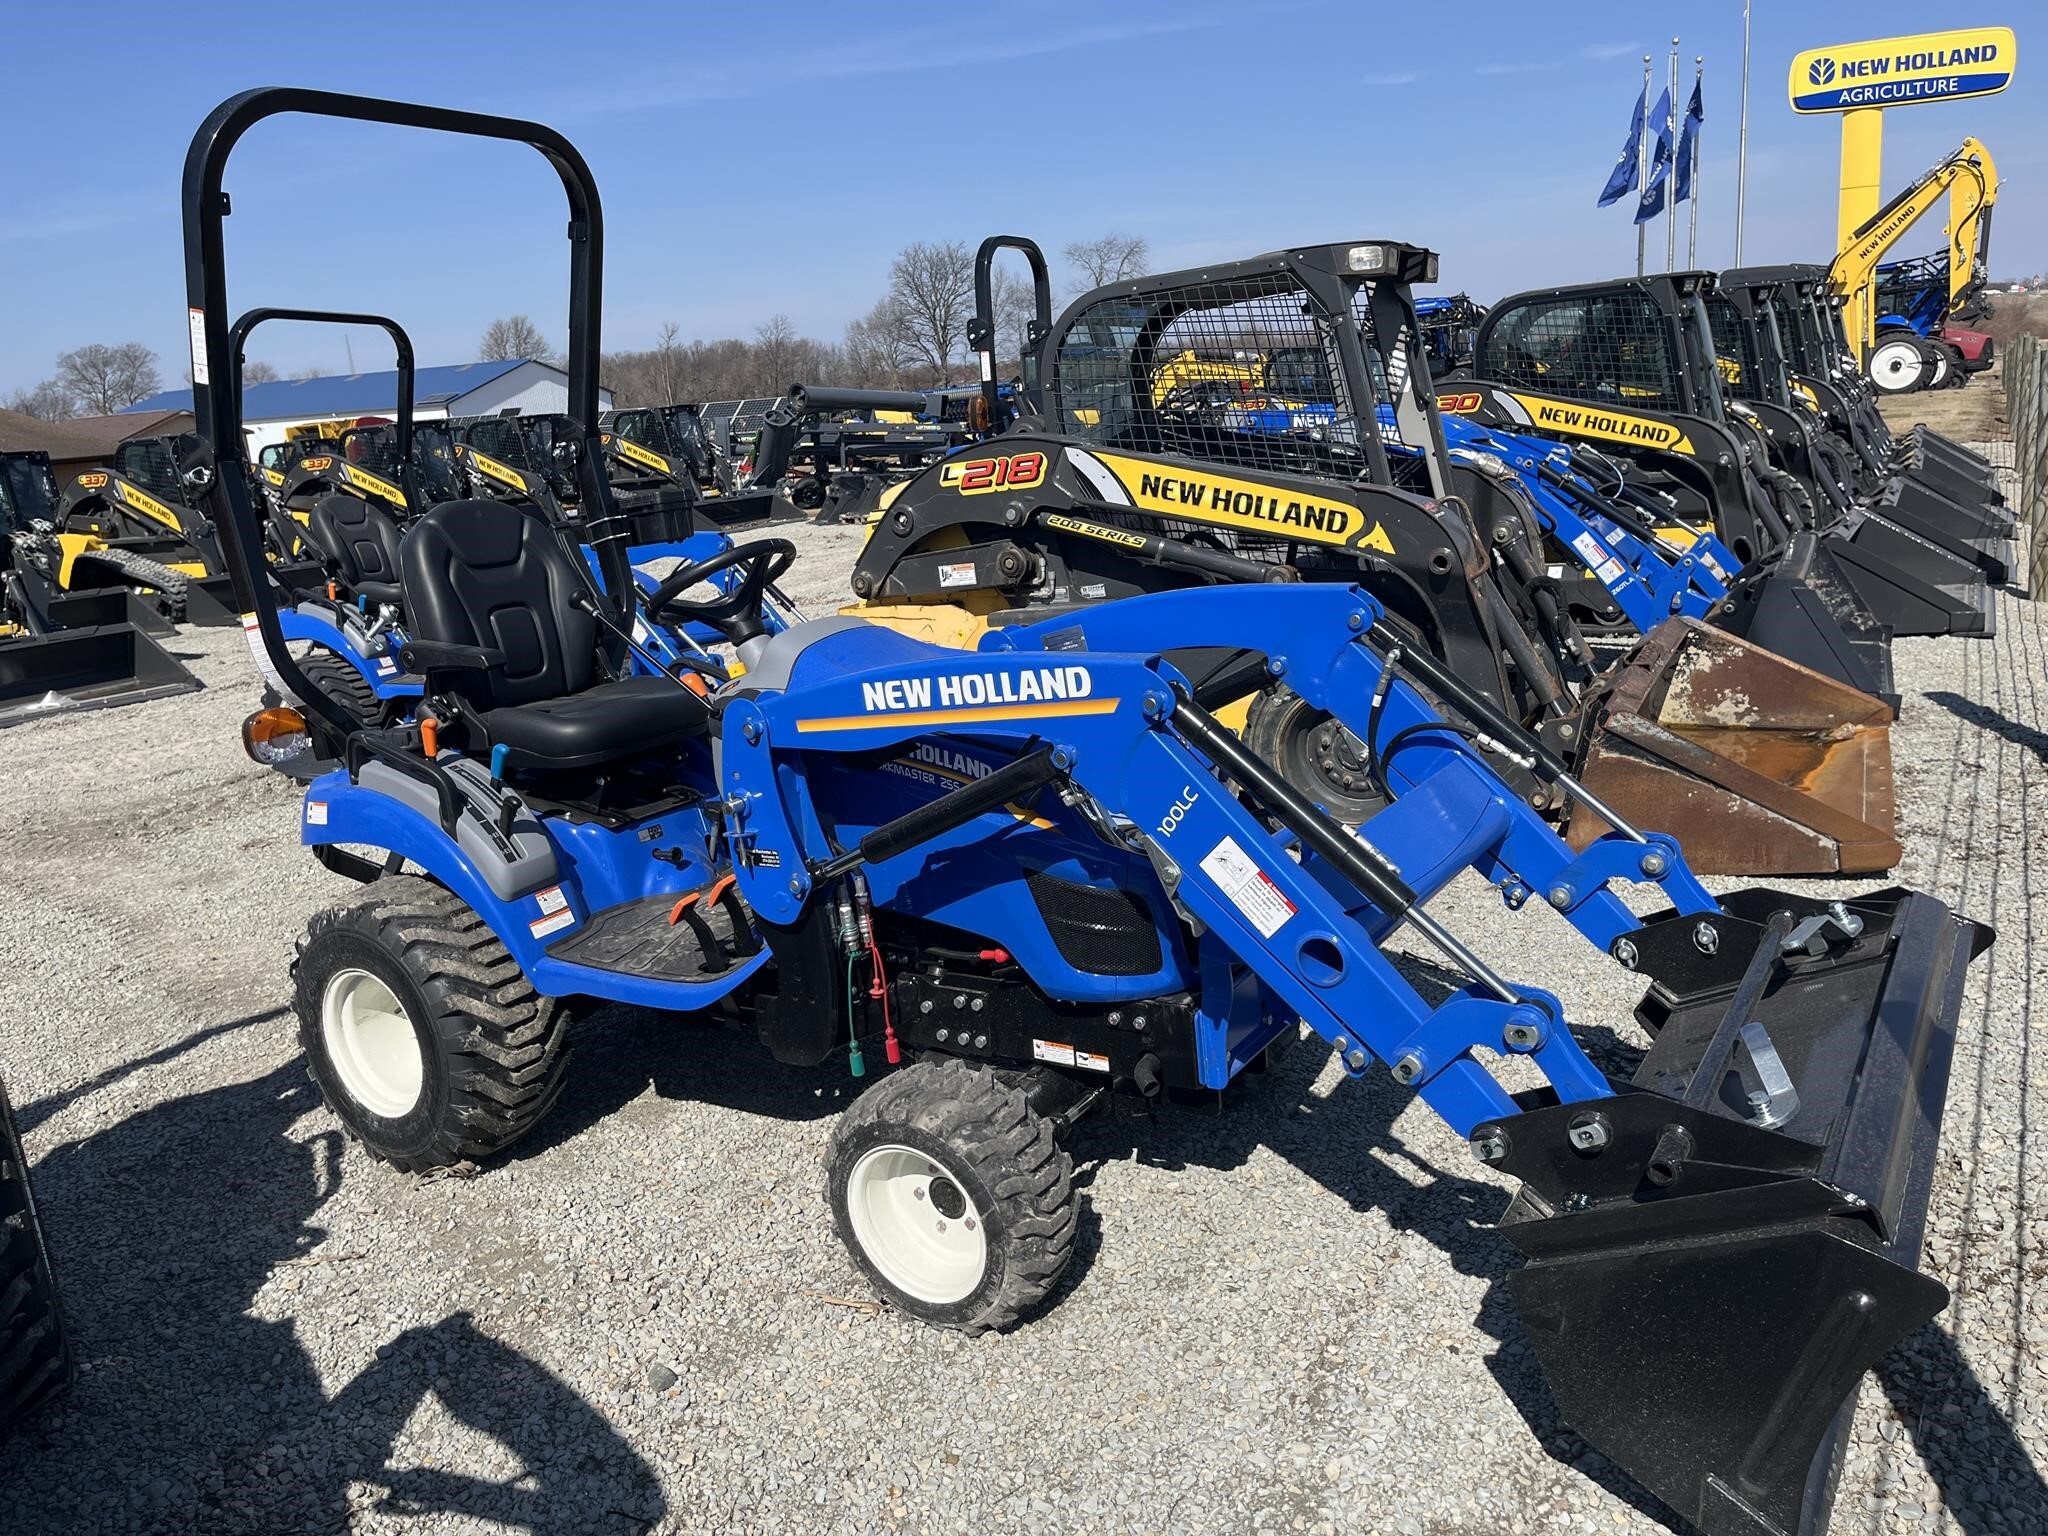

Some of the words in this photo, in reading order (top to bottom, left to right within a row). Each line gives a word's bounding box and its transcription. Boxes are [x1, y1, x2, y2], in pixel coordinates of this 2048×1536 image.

[1841, 57, 1890, 78] NEW
[1895, 44, 1997, 72] HOLLAND
[1839, 77, 1958, 103] AGRICULTURE
[1859, 239, 1879, 259] NEW
[1878, 205, 1916, 242] HOLLAND
[1438, 393, 1482, 412] 30
[1293, 413, 1330, 428] NEW
[1539, 406, 1580, 426] NEW
[1584, 414, 1671, 443] HOLLAND
[478, 459, 492, 472] NEW
[492, 464, 518, 483] HOLLAND
[626, 445, 637, 454] NEW
[637, 448, 662, 466] HOLLAND
[352, 473, 367, 486] NEW
[367, 480, 397, 499] HOLLAND
[941, 453, 1047, 493] L218
[126, 490, 141, 504] NEW
[141, 498, 171, 521] HOLLAND
[1141, 473, 1208, 505] NEW
[1211, 486, 1349, 533] HOLLAND
[1049, 514, 1083, 530] 200
[1084, 525, 1145, 545] SERIES
[862, 678, 931, 711] NEW
[937, 666, 1092, 706] HOLLAND
[880, 761, 936, 785] RKMASTER
[1157, 785, 1199, 837] 100LC
